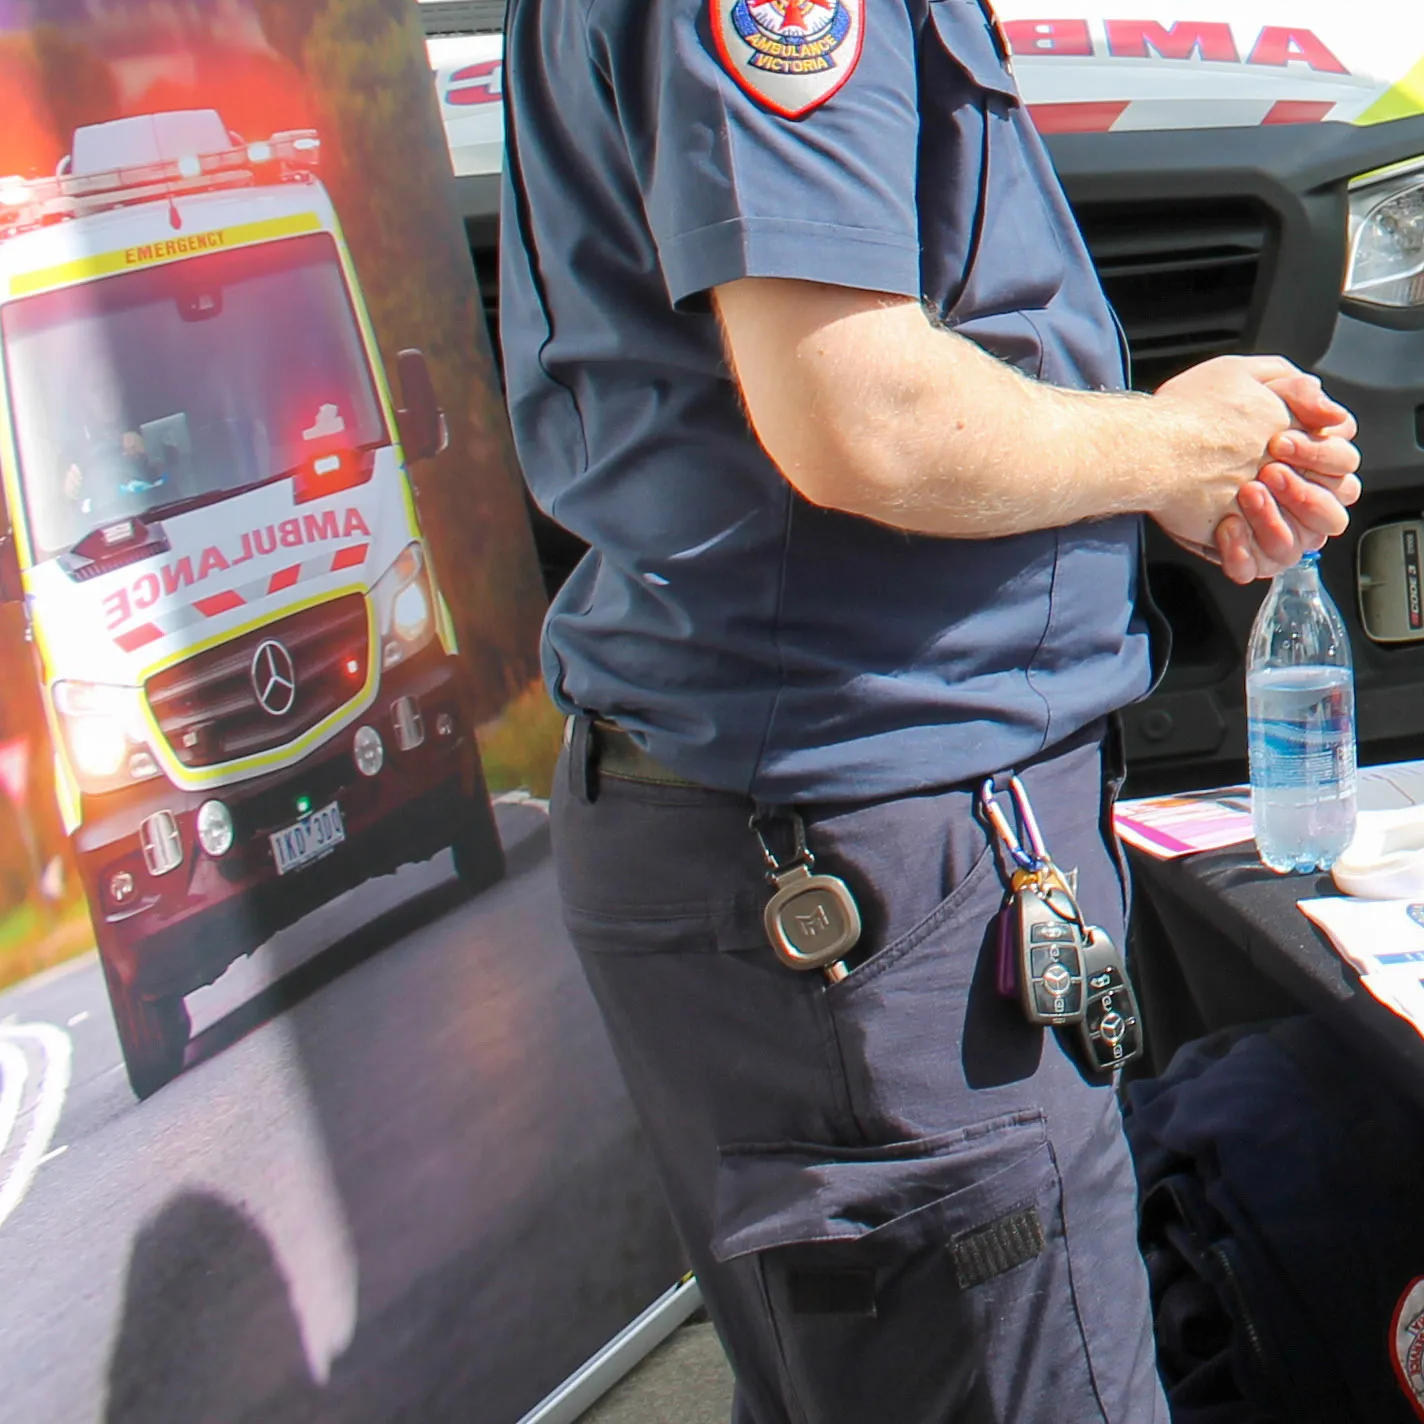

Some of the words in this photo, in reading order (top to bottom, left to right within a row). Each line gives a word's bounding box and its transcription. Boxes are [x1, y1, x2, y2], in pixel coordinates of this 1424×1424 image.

[747, 33, 837, 57] AMBULANCE
[756, 53, 830, 73] VICTORIA
[125, 231, 226, 264] EMERGENCY
[1410, 577, 1420, 613] CODE
